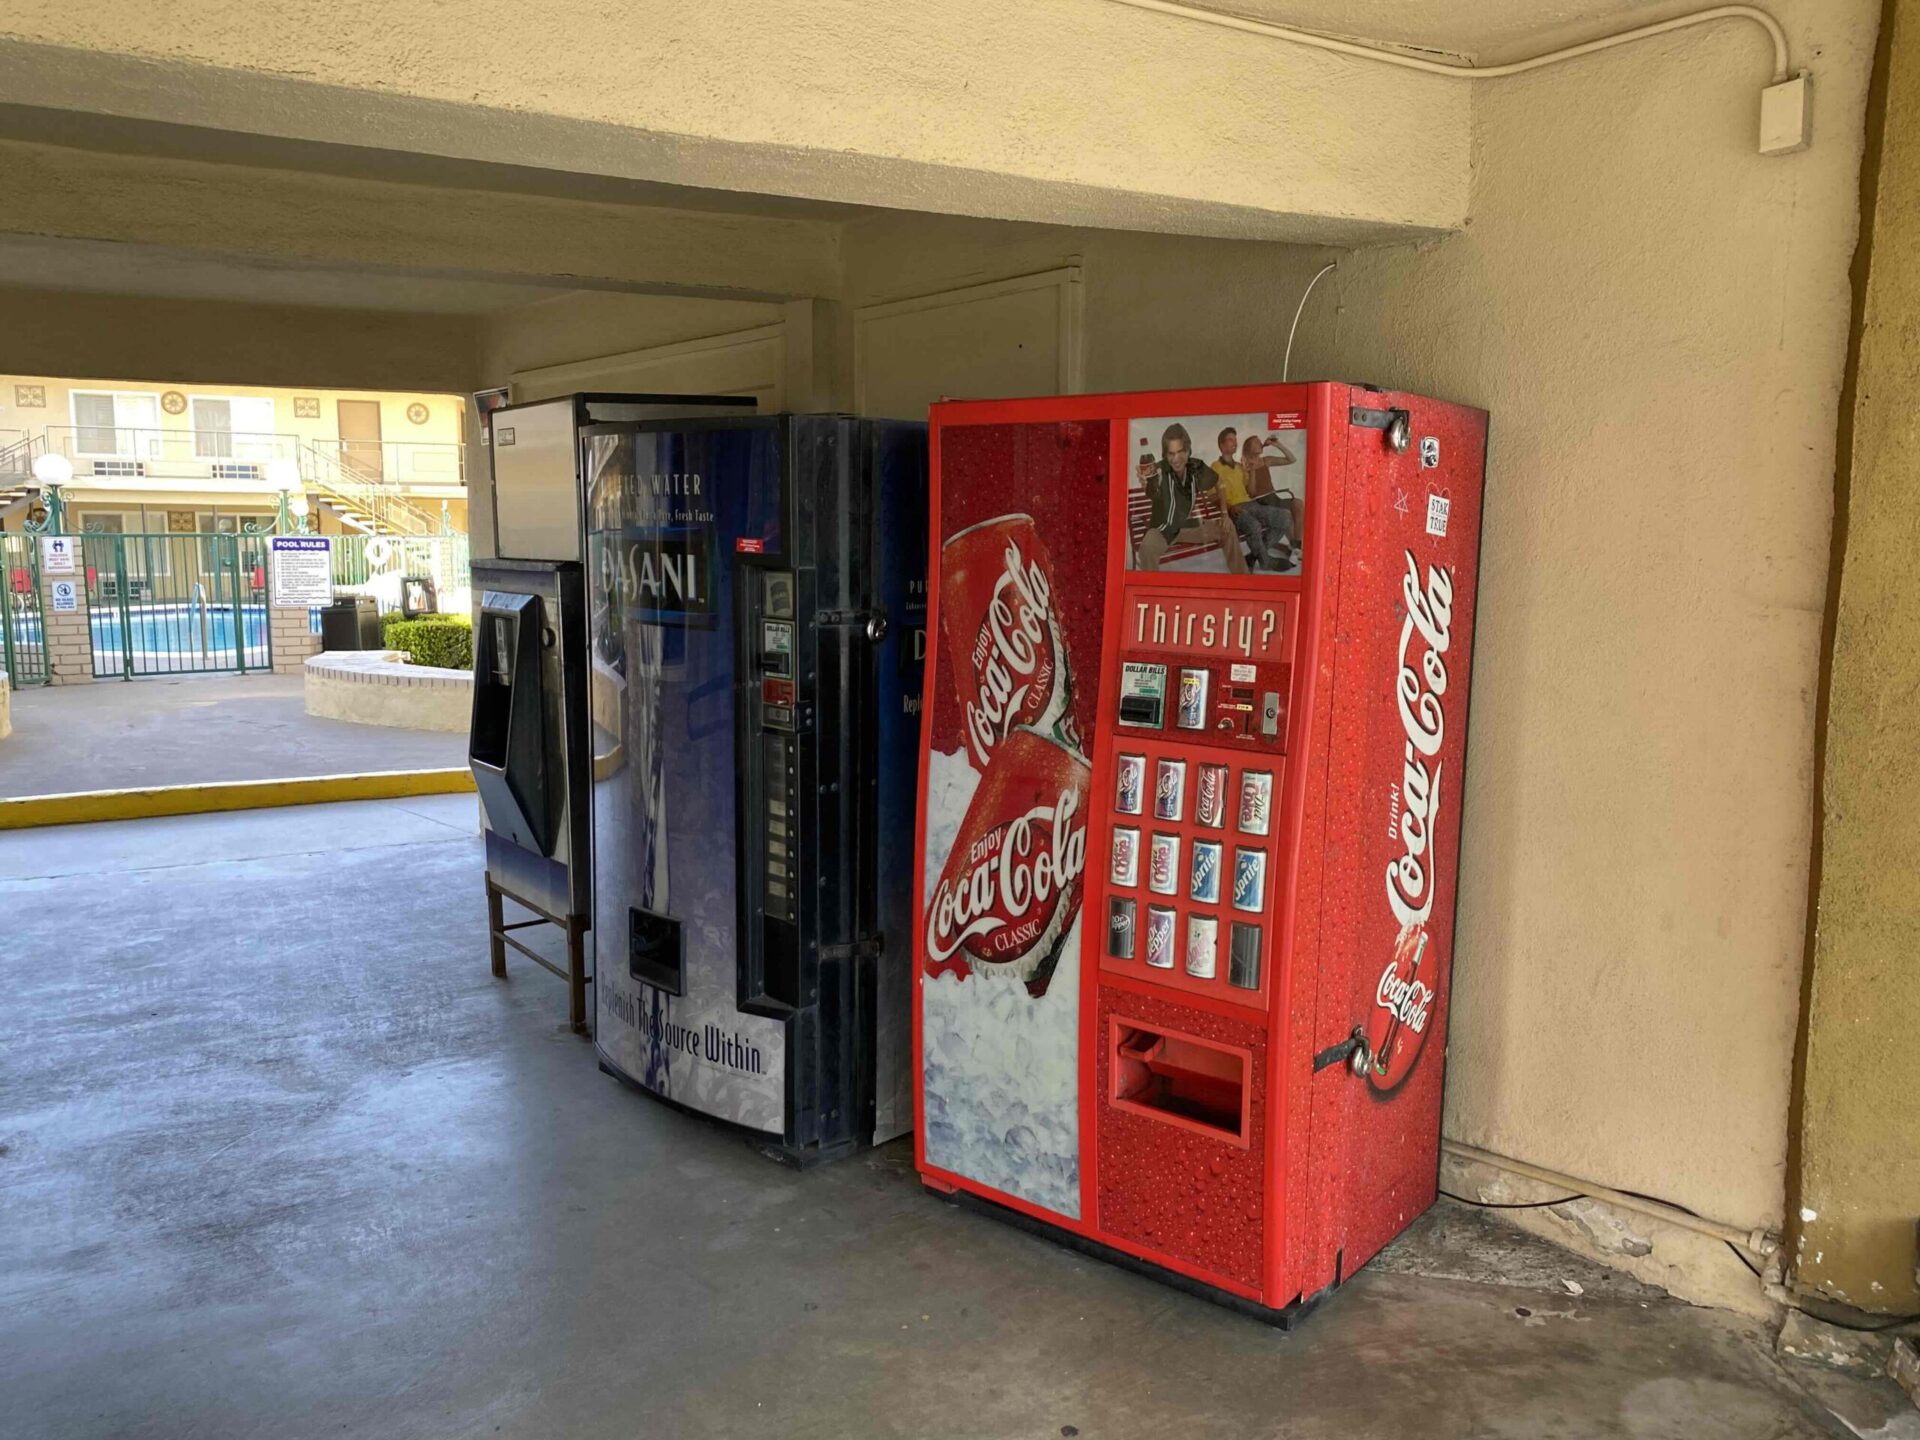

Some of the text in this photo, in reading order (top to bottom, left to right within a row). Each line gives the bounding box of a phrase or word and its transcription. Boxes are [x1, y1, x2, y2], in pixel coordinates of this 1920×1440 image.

[651, 474, 701, 496] WATER
[675, 509, 693, 521] Fresh
[695, 509, 714, 522] Taste
[1430, 516, 1446, 533] TRUE
[603, 543, 696, 601] DASANI
[966, 535, 1050, 767] Coca-Cola
[972, 622, 992, 671] Enjoy
[1137, 603, 1275, 657] Thirsty?
[1027, 657, 1054, 710] CLASSIC
[1125, 665, 1165, 675] DOLLAR BILLS
[1386, 549, 1453, 928] Coca-Cola
[1388, 783, 1399, 840] Drink!
[927, 782, 1086, 962] Coca-Cola
[970, 827, 1001, 864] Enjoy
[994, 918, 1041, 951] CLASSIC
[1376, 961, 1434, 1034] Coca-Cola
[637, 997, 655, 1038] The
[658, 1009, 699, 1056] Source
[705, 1024, 761, 1074] Within
